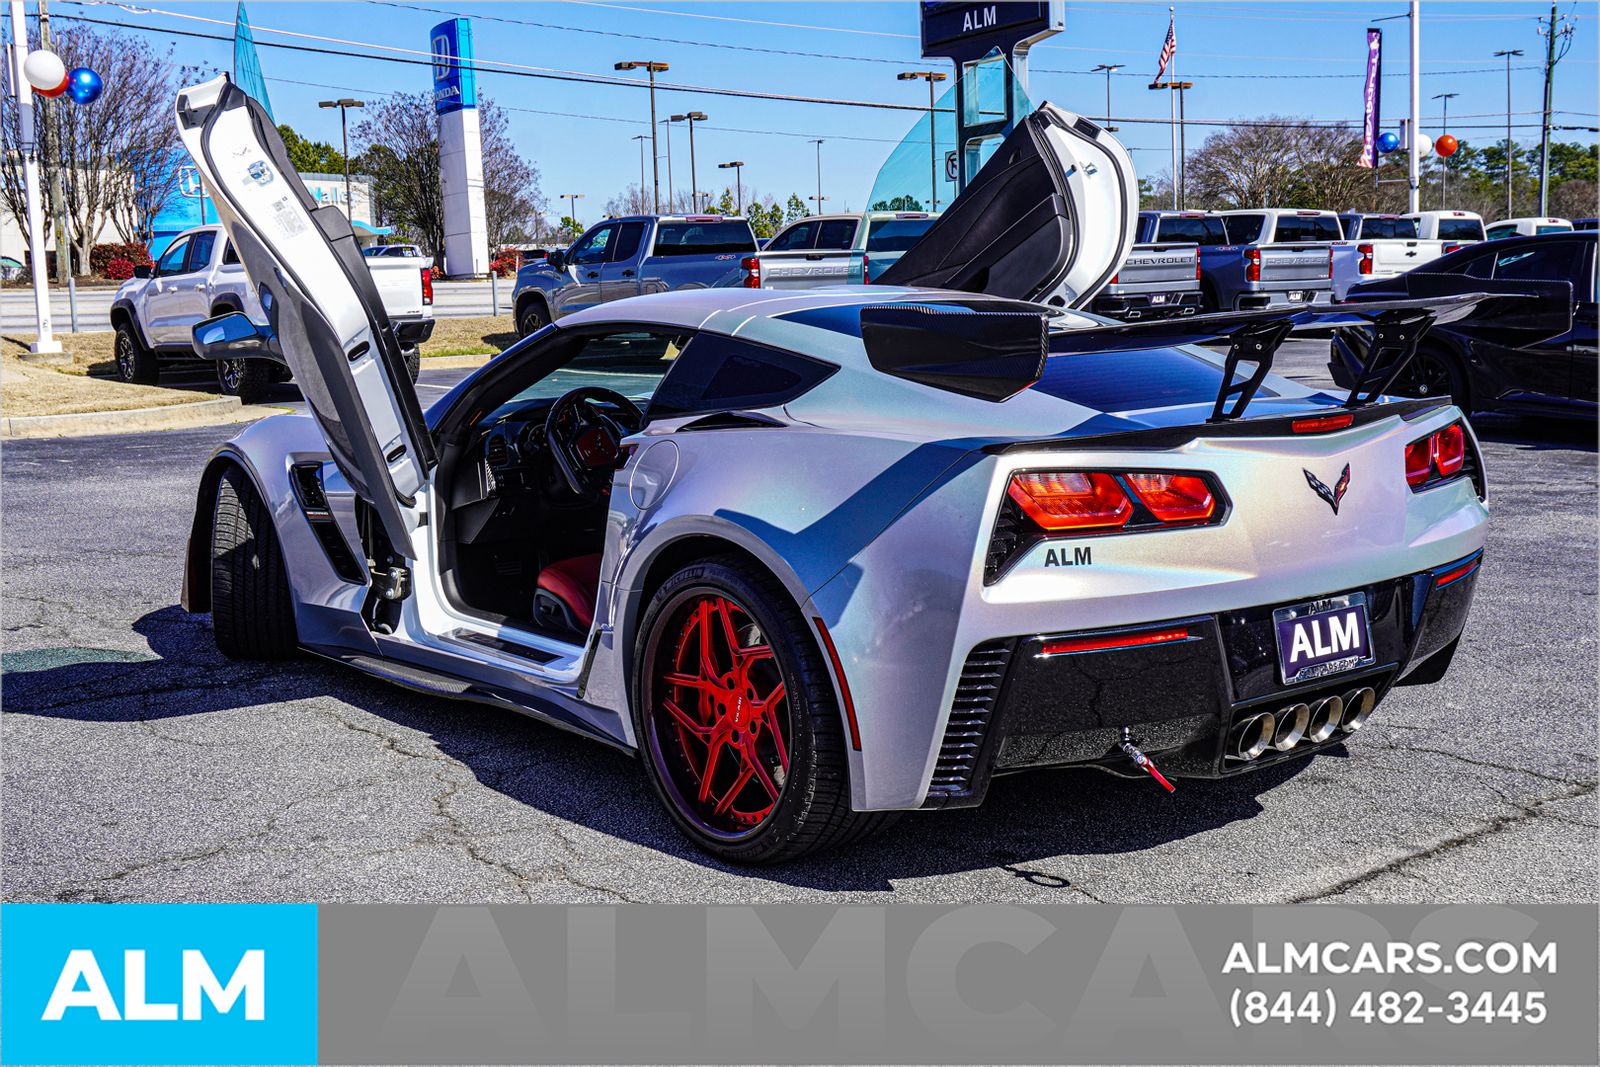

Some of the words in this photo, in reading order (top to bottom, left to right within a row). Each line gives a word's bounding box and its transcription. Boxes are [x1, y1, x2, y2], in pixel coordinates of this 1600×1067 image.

[962, 5, 996, 32] ALM
[1125, 257, 1193, 266] CHEVROLET
[769, 265, 859, 277] CHEVROLET
[1151, 295, 1166, 304] ALM
[1044, 546, 1092, 568] ALM
[1309, 599, 1332, 615] ALM
[1290, 612, 1360, 663] ALM
